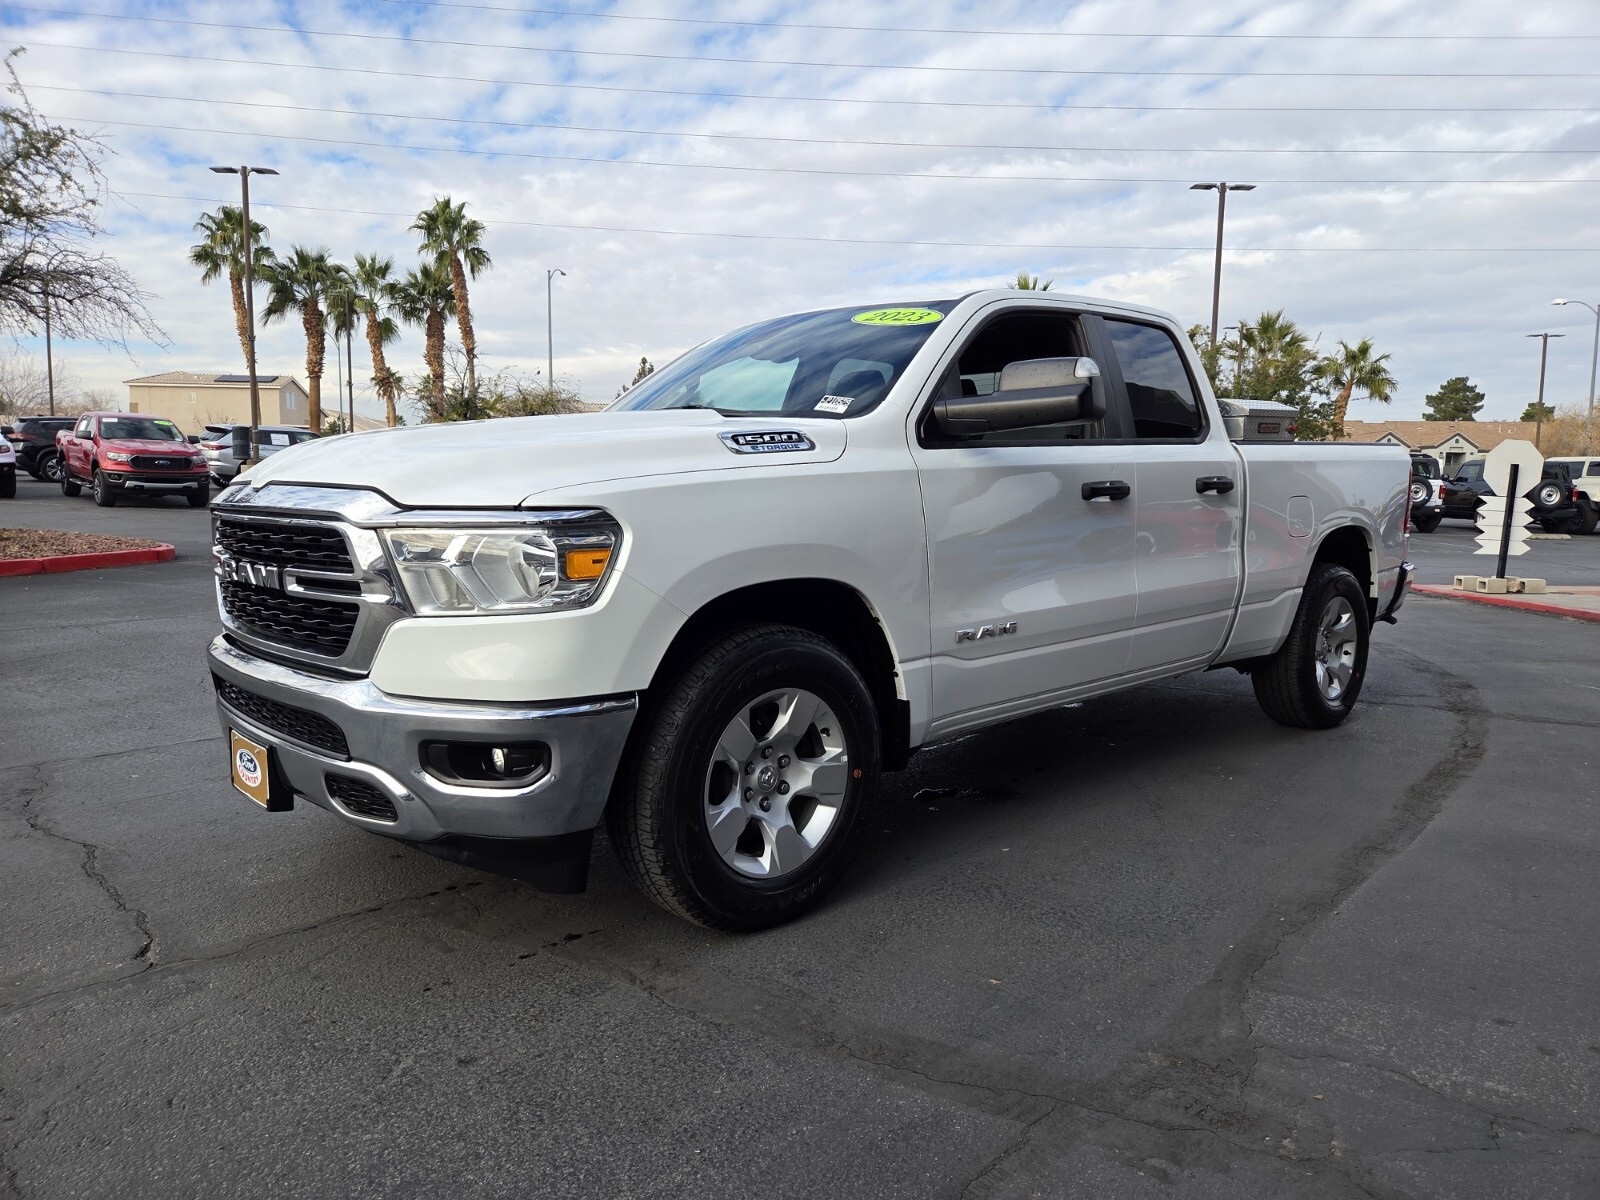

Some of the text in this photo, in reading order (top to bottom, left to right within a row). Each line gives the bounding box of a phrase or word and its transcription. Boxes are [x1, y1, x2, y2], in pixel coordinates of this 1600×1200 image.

[862, 311, 932, 322] 2023
[735, 433, 798, 445] 1500
[222, 557, 280, 590] RAM
[955, 621, 1018, 643] RAM
